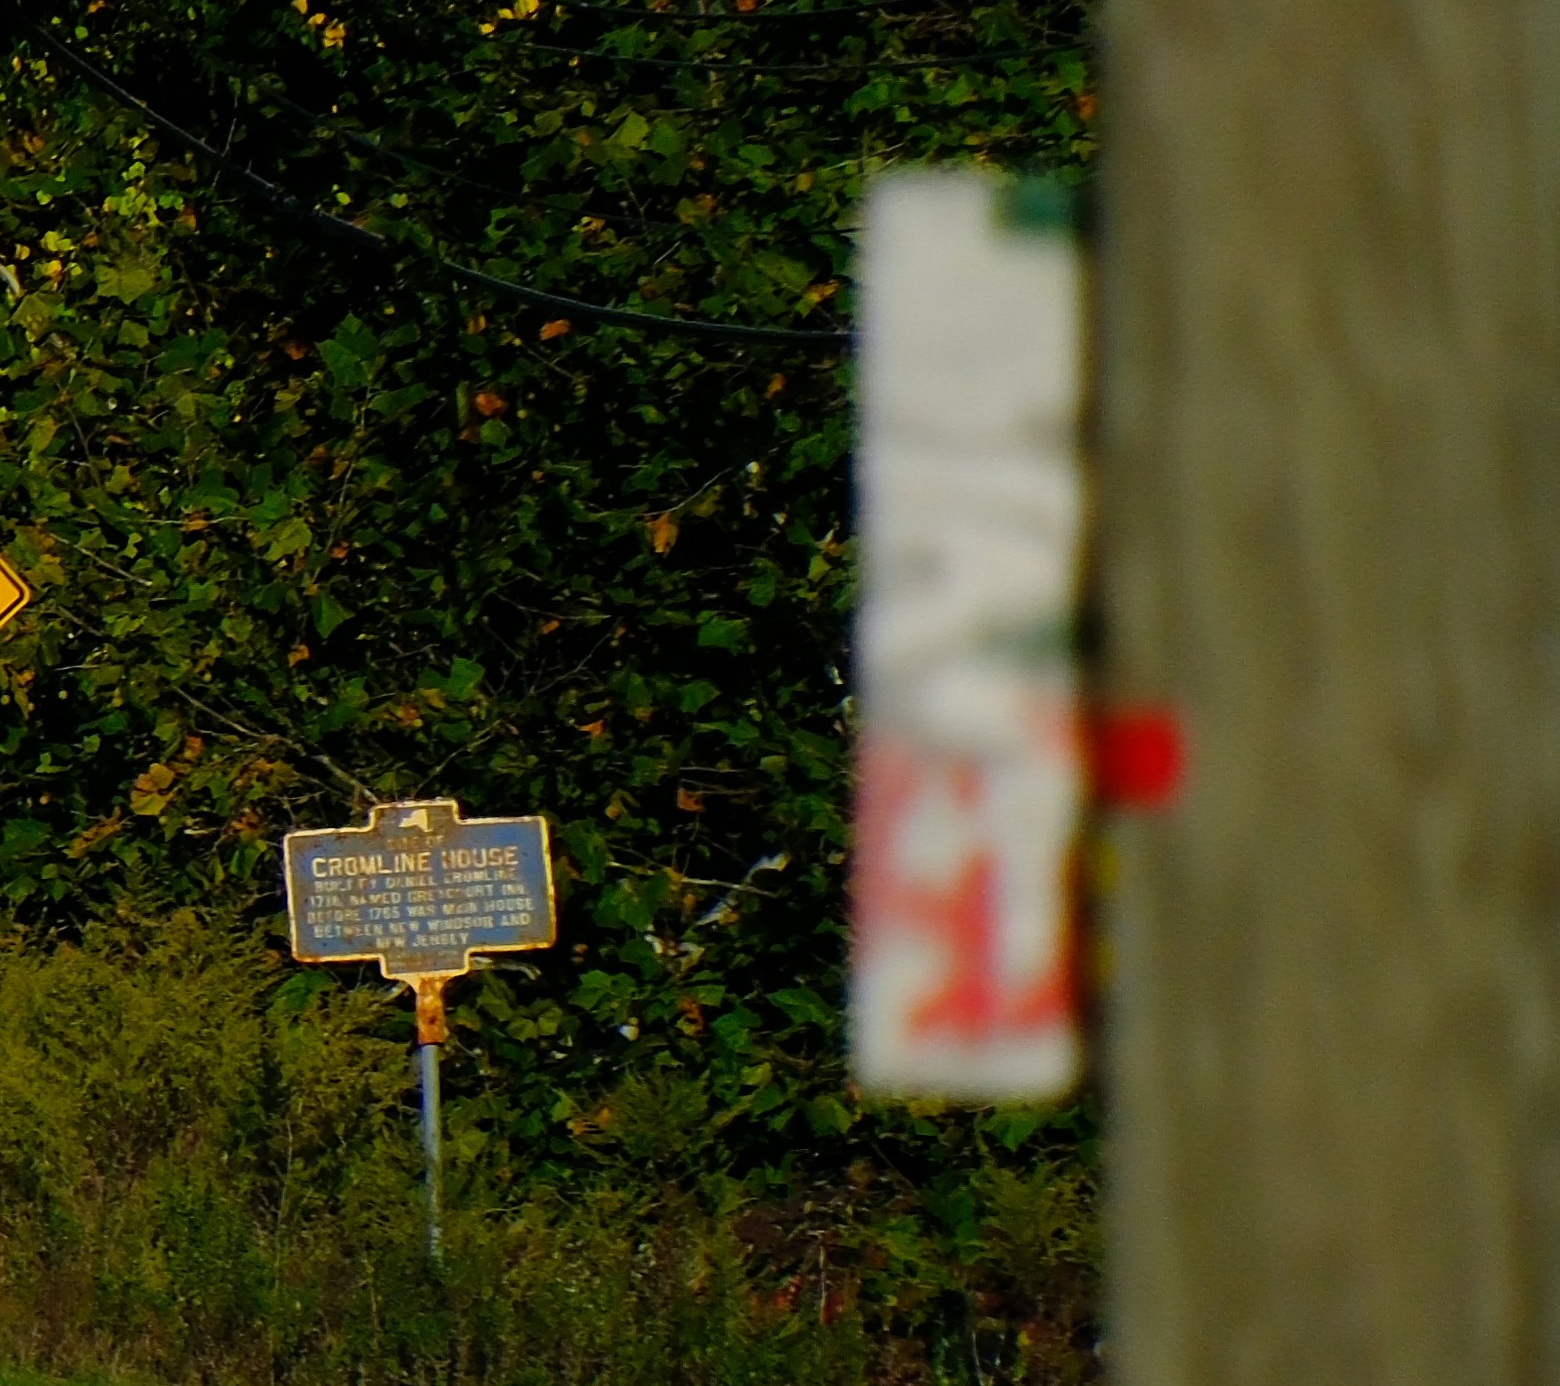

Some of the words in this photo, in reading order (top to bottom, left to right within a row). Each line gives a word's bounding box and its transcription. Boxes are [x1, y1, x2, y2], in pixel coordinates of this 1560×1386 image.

[311, 851, 432, 878] CROMLINE
[441, 846, 519, 870] HOUSE
[443, 867, 517, 884] CROMLINE
[368, 905, 400, 921] 1765
[484, 897, 535, 913] HOUSE
[314, 922, 383, 939] BETWEEN
[428, 915, 494, 931] WINDSOR
[501, 912, 531, 927] AND
[412, 932, 469, 948] JERSEY
